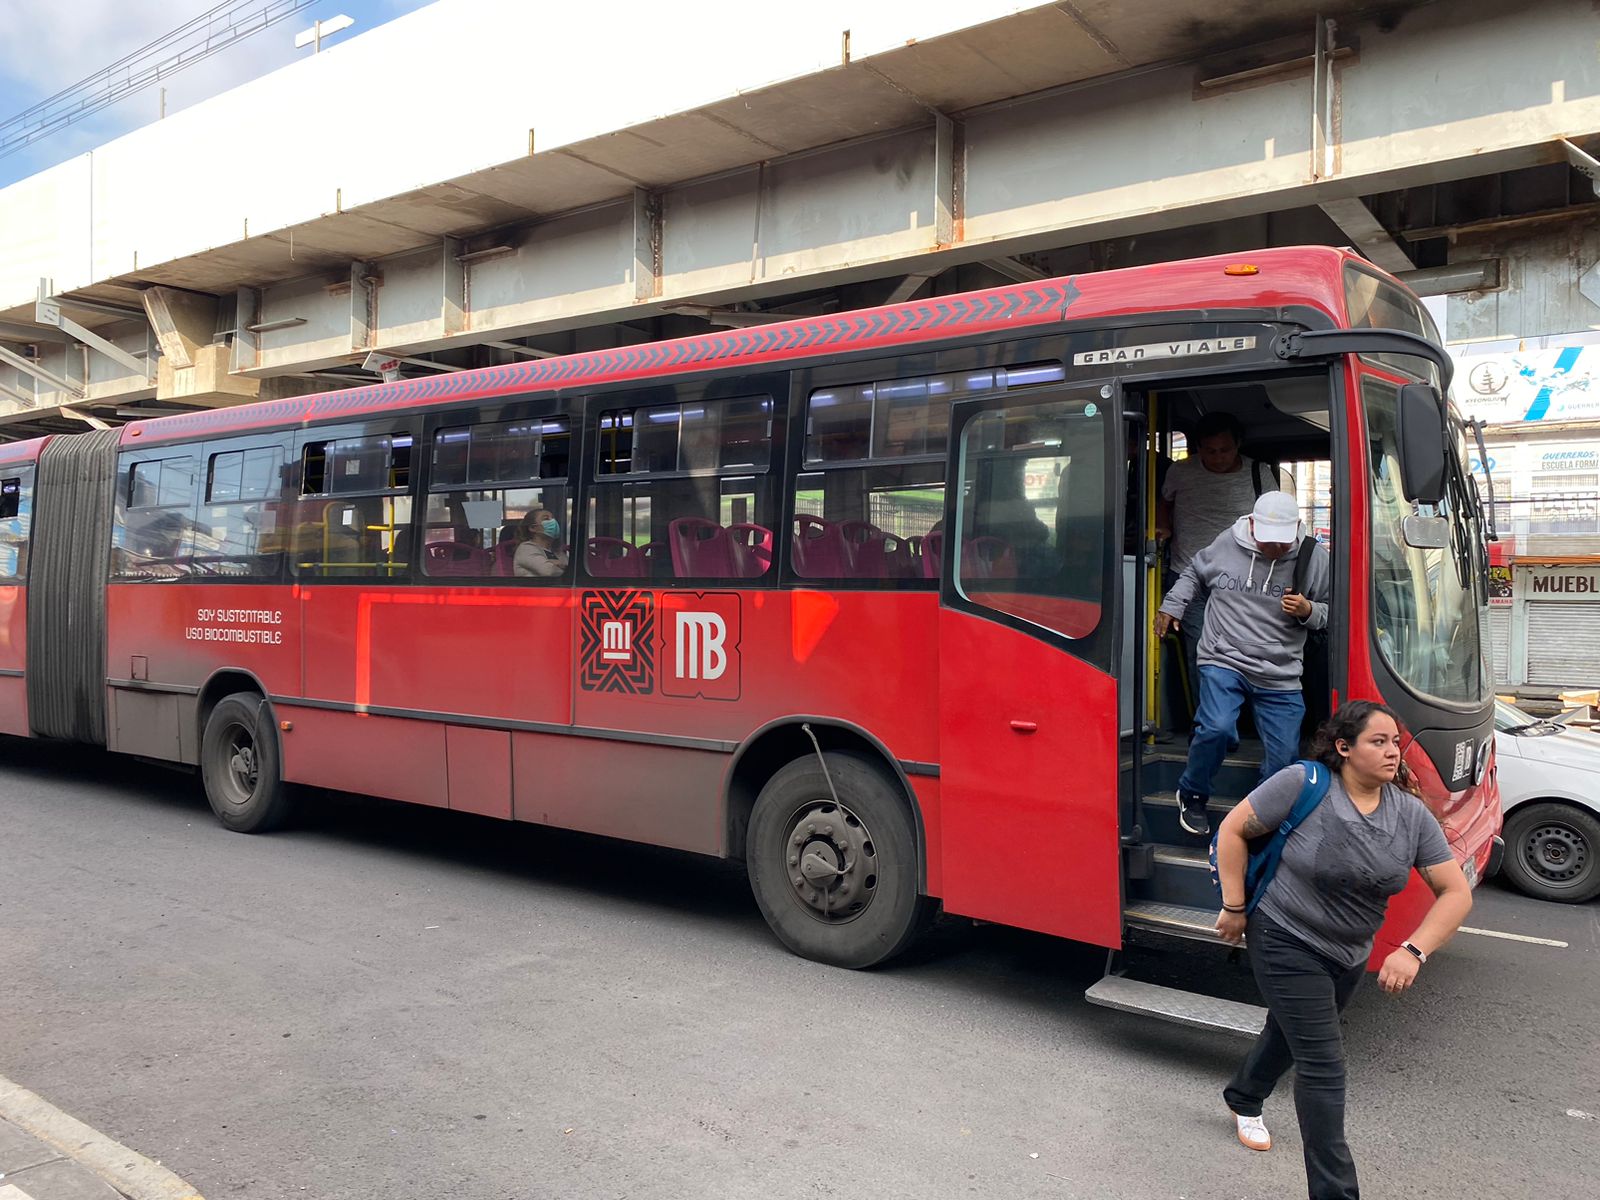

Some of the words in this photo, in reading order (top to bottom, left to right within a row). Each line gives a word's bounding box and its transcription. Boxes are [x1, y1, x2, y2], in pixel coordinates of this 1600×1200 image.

[1083, 348, 1145, 363] GRAN
[1169, 338, 1245, 355] VIALE
[1542, 450, 1595, 460] GUERREROS
[1541, 460, 1573, 470] ESCUELA
[1533, 575, 1599, 593] MUEBL
[197, 608, 215, 622] SOY
[217, 609, 282, 624] SUSTENTABLE
[185, 627, 203, 640] USO
[204, 628, 282, 644] BIOCOMBUSTIBLE
[675, 611, 727, 680] MB
